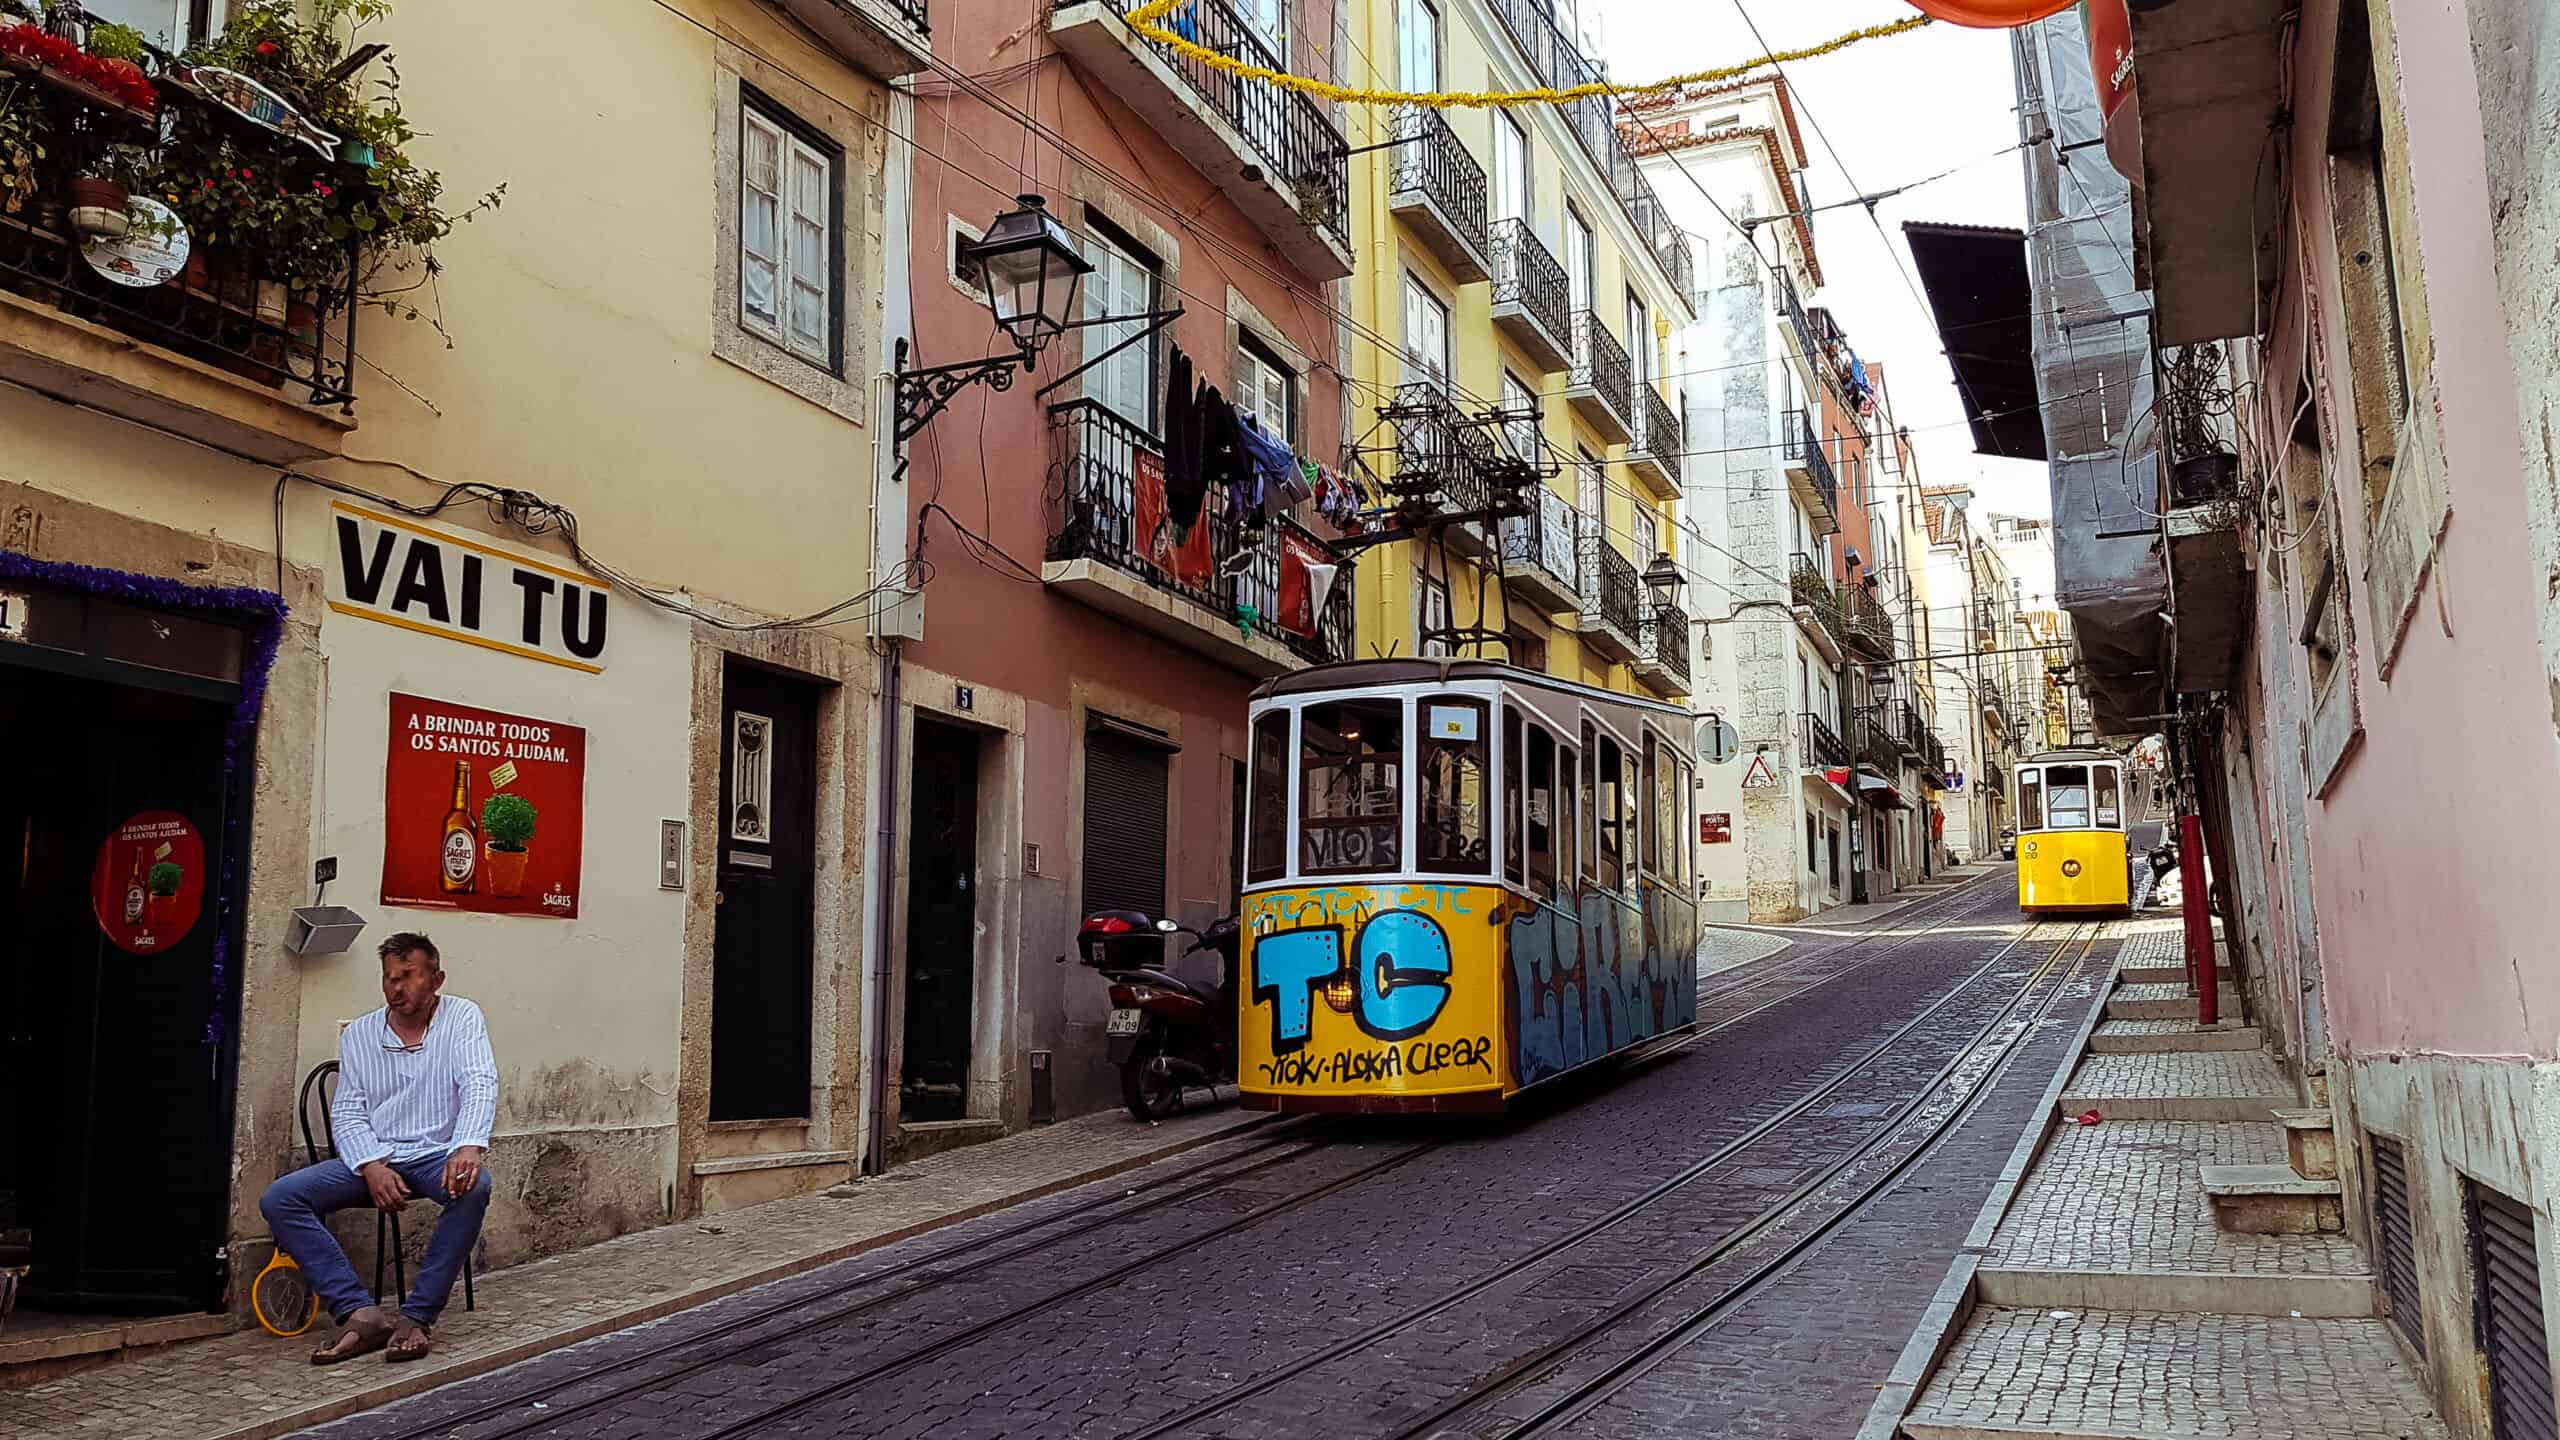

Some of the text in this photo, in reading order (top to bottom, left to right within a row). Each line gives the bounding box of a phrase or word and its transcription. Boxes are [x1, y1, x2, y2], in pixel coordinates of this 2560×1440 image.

[2111, 48, 2133, 91] SAGRES
[336, 515, 608, 659] VAI TU
[961, 688, 968, 708] 5
[408, 713, 550, 743] A BRINDAR TODOS
[411, 733, 569, 763] OS SANTOS AJUDAM.
[542, 892, 572, 907] SAGRES
